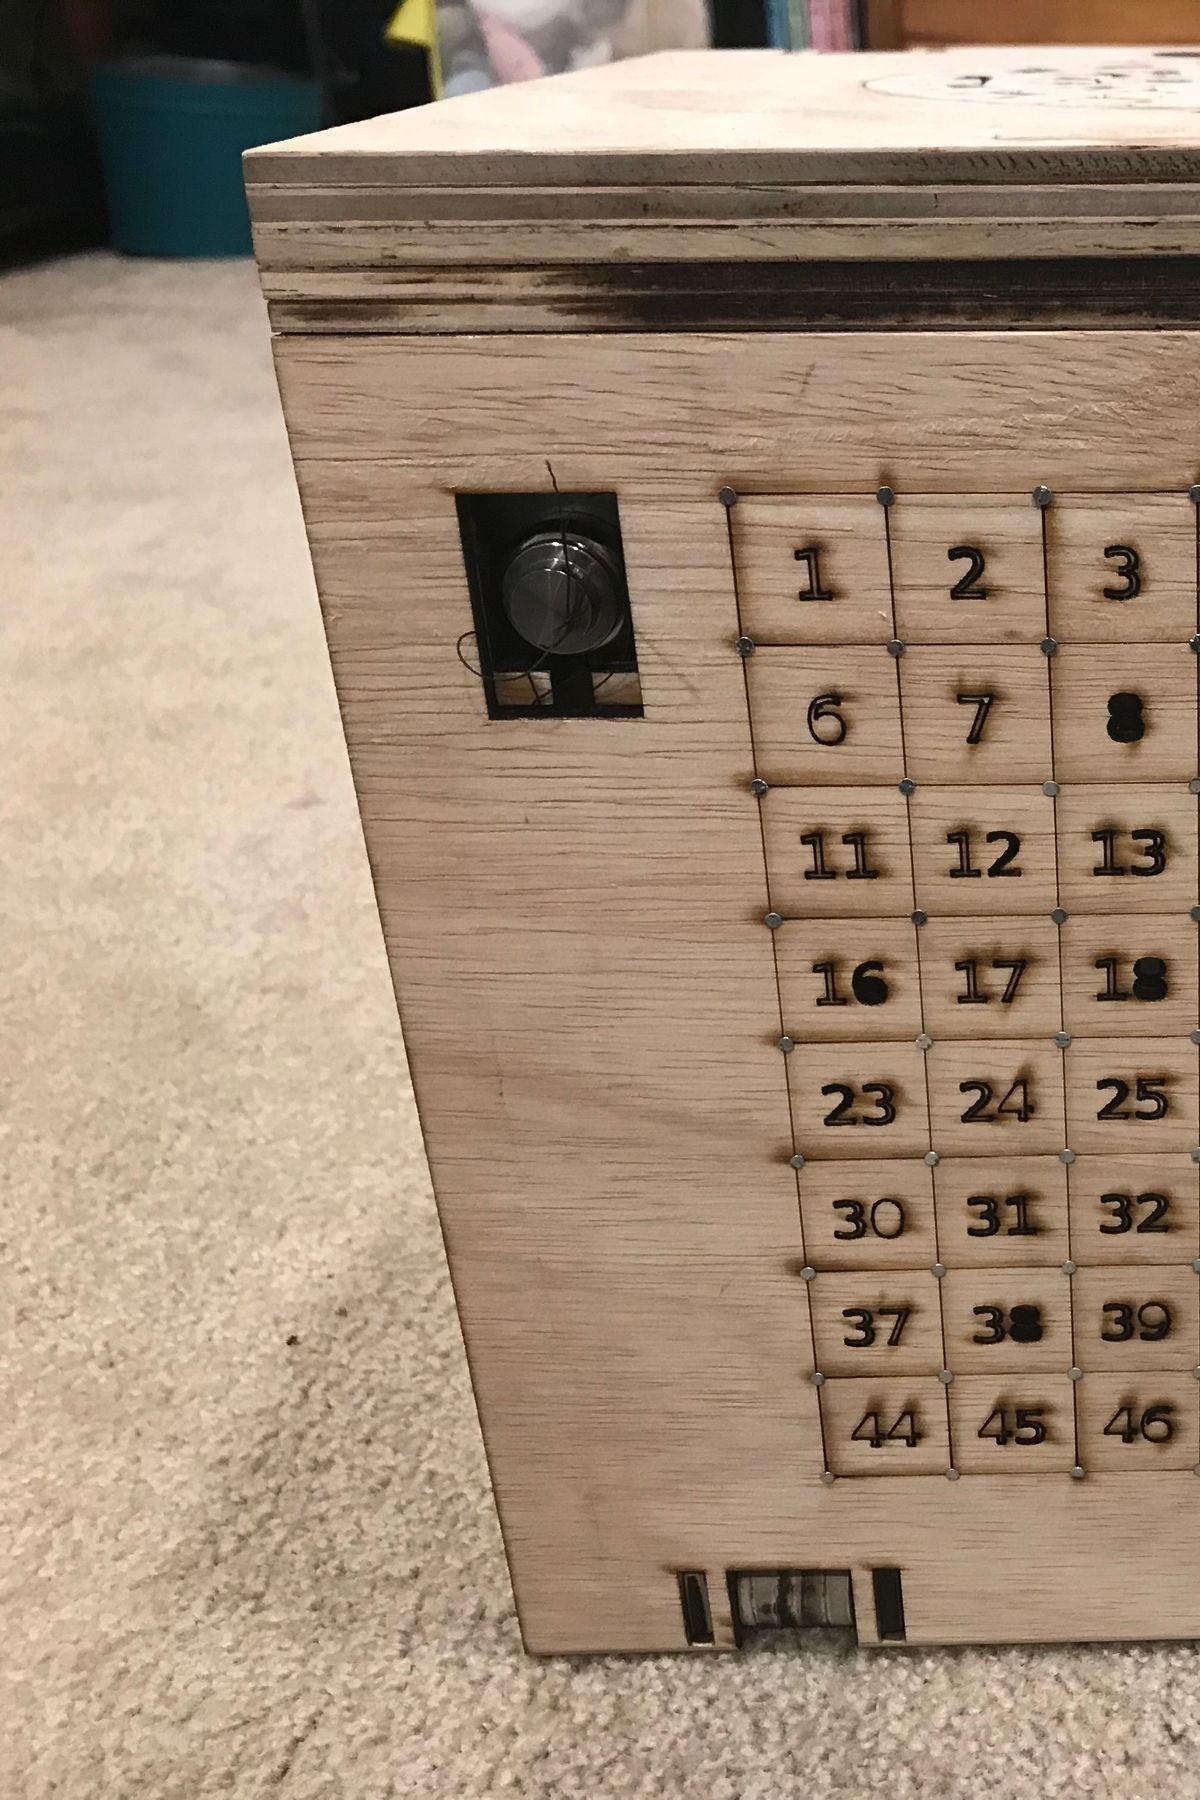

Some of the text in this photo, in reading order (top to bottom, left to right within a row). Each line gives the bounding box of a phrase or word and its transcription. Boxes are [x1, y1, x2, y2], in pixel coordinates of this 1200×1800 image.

[794, 546, 837, 601] 1
[947, 546, 992, 600] 2
[1103, 545, 1142, 601] 3
[807, 693, 848, 746] 6
[956, 693, 999, 744] 7
[1106, 693, 1148, 743] 8
[800, 831, 881, 879] 11
[946, 829, 1022, 878] 12
[1091, 828, 1167, 876] 13
[811, 961, 889, 1006] 16
[954, 958, 1029, 1003] 17
[1094, 957, 1169, 1001] 18
[821, 1083, 897, 1126] 23
[959, 1078, 1035, 1123] 24
[1096, 1078, 1169, 1120] 25
[832, 1198, 906, 1240] 30
[967, 1193, 1045, 1237] 31
[1099, 1193, 1174, 1234] 32
[842, 1307, 914, 1347] 37
[973, 1305, 1044, 1344] 38
[1101, 1302, 1173, 1341] 39
[851, 1410, 925, 1448] 44
[977, 1408, 1048, 1445] 45
[1103, 1405, 1176, 1443] 46
